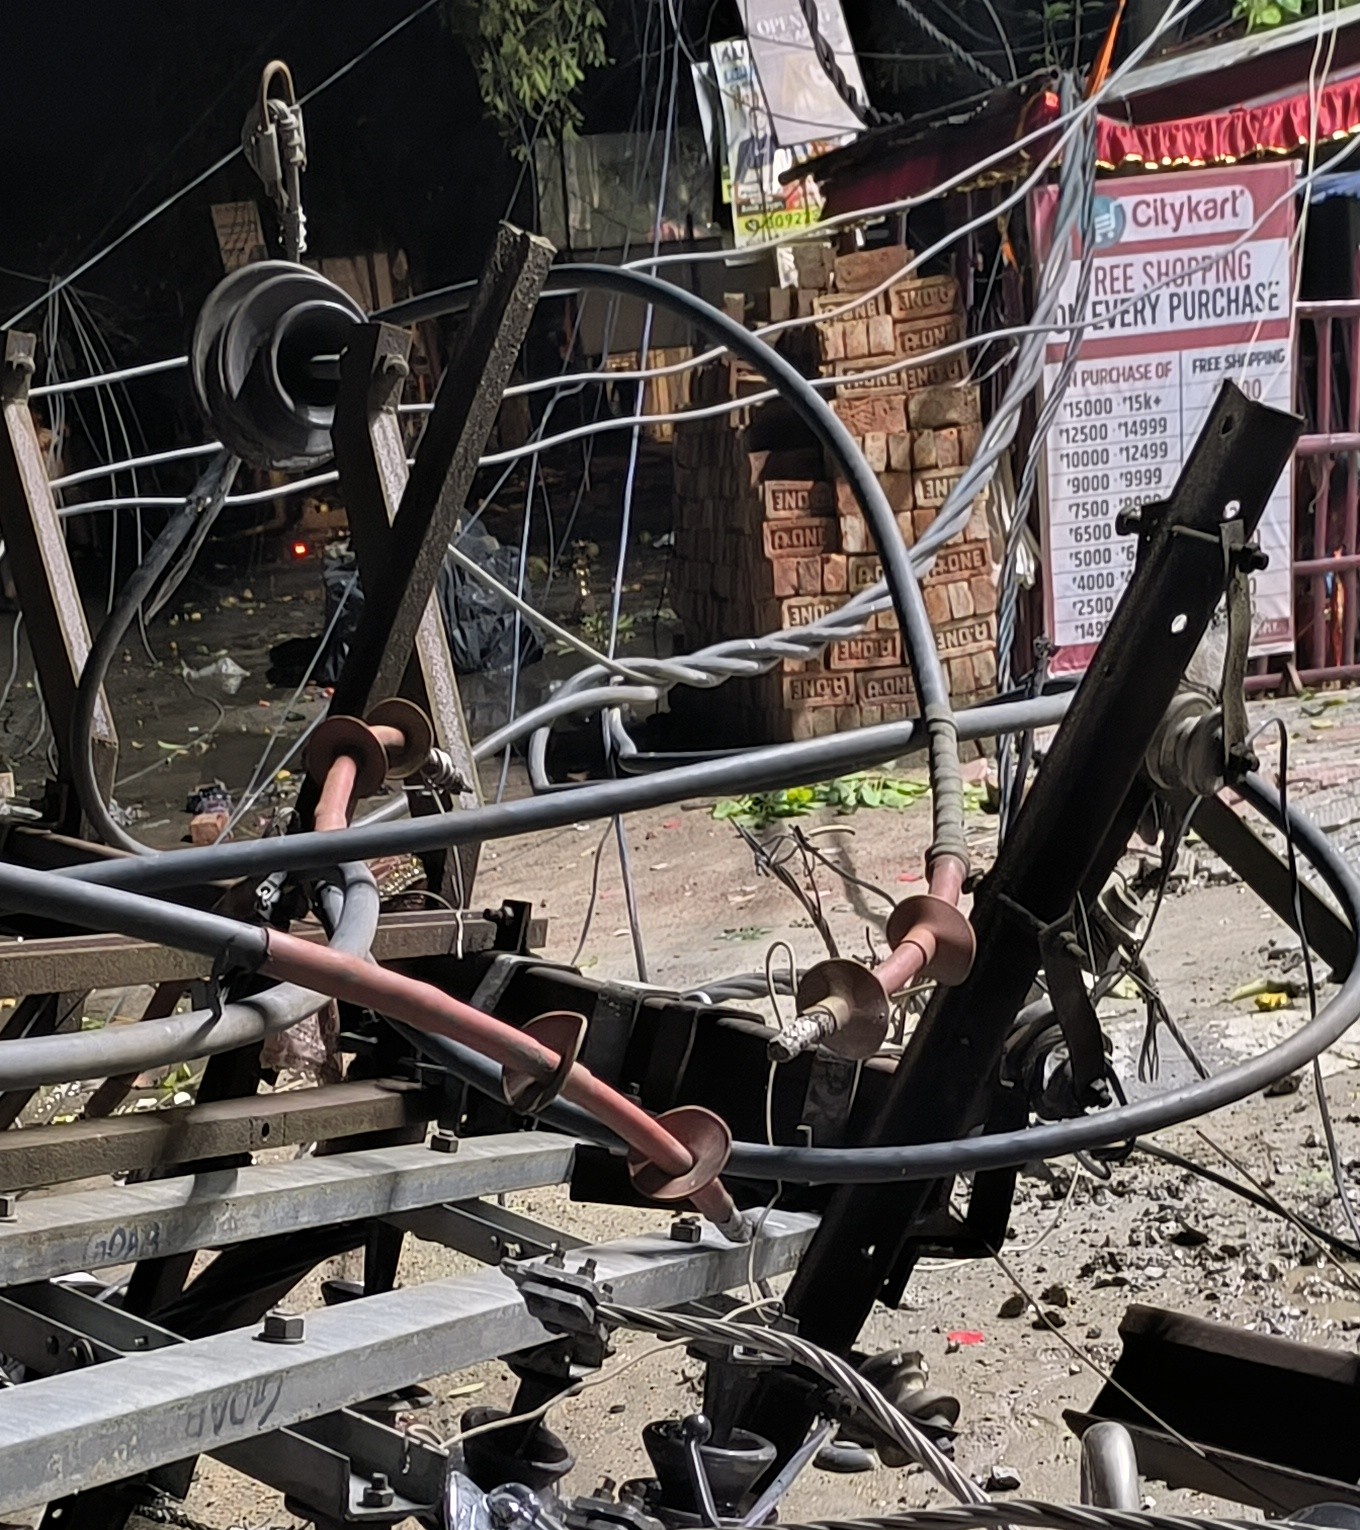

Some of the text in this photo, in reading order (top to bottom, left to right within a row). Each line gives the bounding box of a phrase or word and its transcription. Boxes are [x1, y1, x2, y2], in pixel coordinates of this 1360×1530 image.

[1132, 188, 1242, 233] Citykart
[1093, 251, 1251, 297] REE SHOPPING
[1092, 294, 1160, 331] EVERY
[1169, 281, 1280, 323] PURCHASE
[1081, 364, 1152, 387] PURCHASE
[1155, 361, 1172, 379] OF
[1192, 349, 1285, 374] FREE SHOPPING
